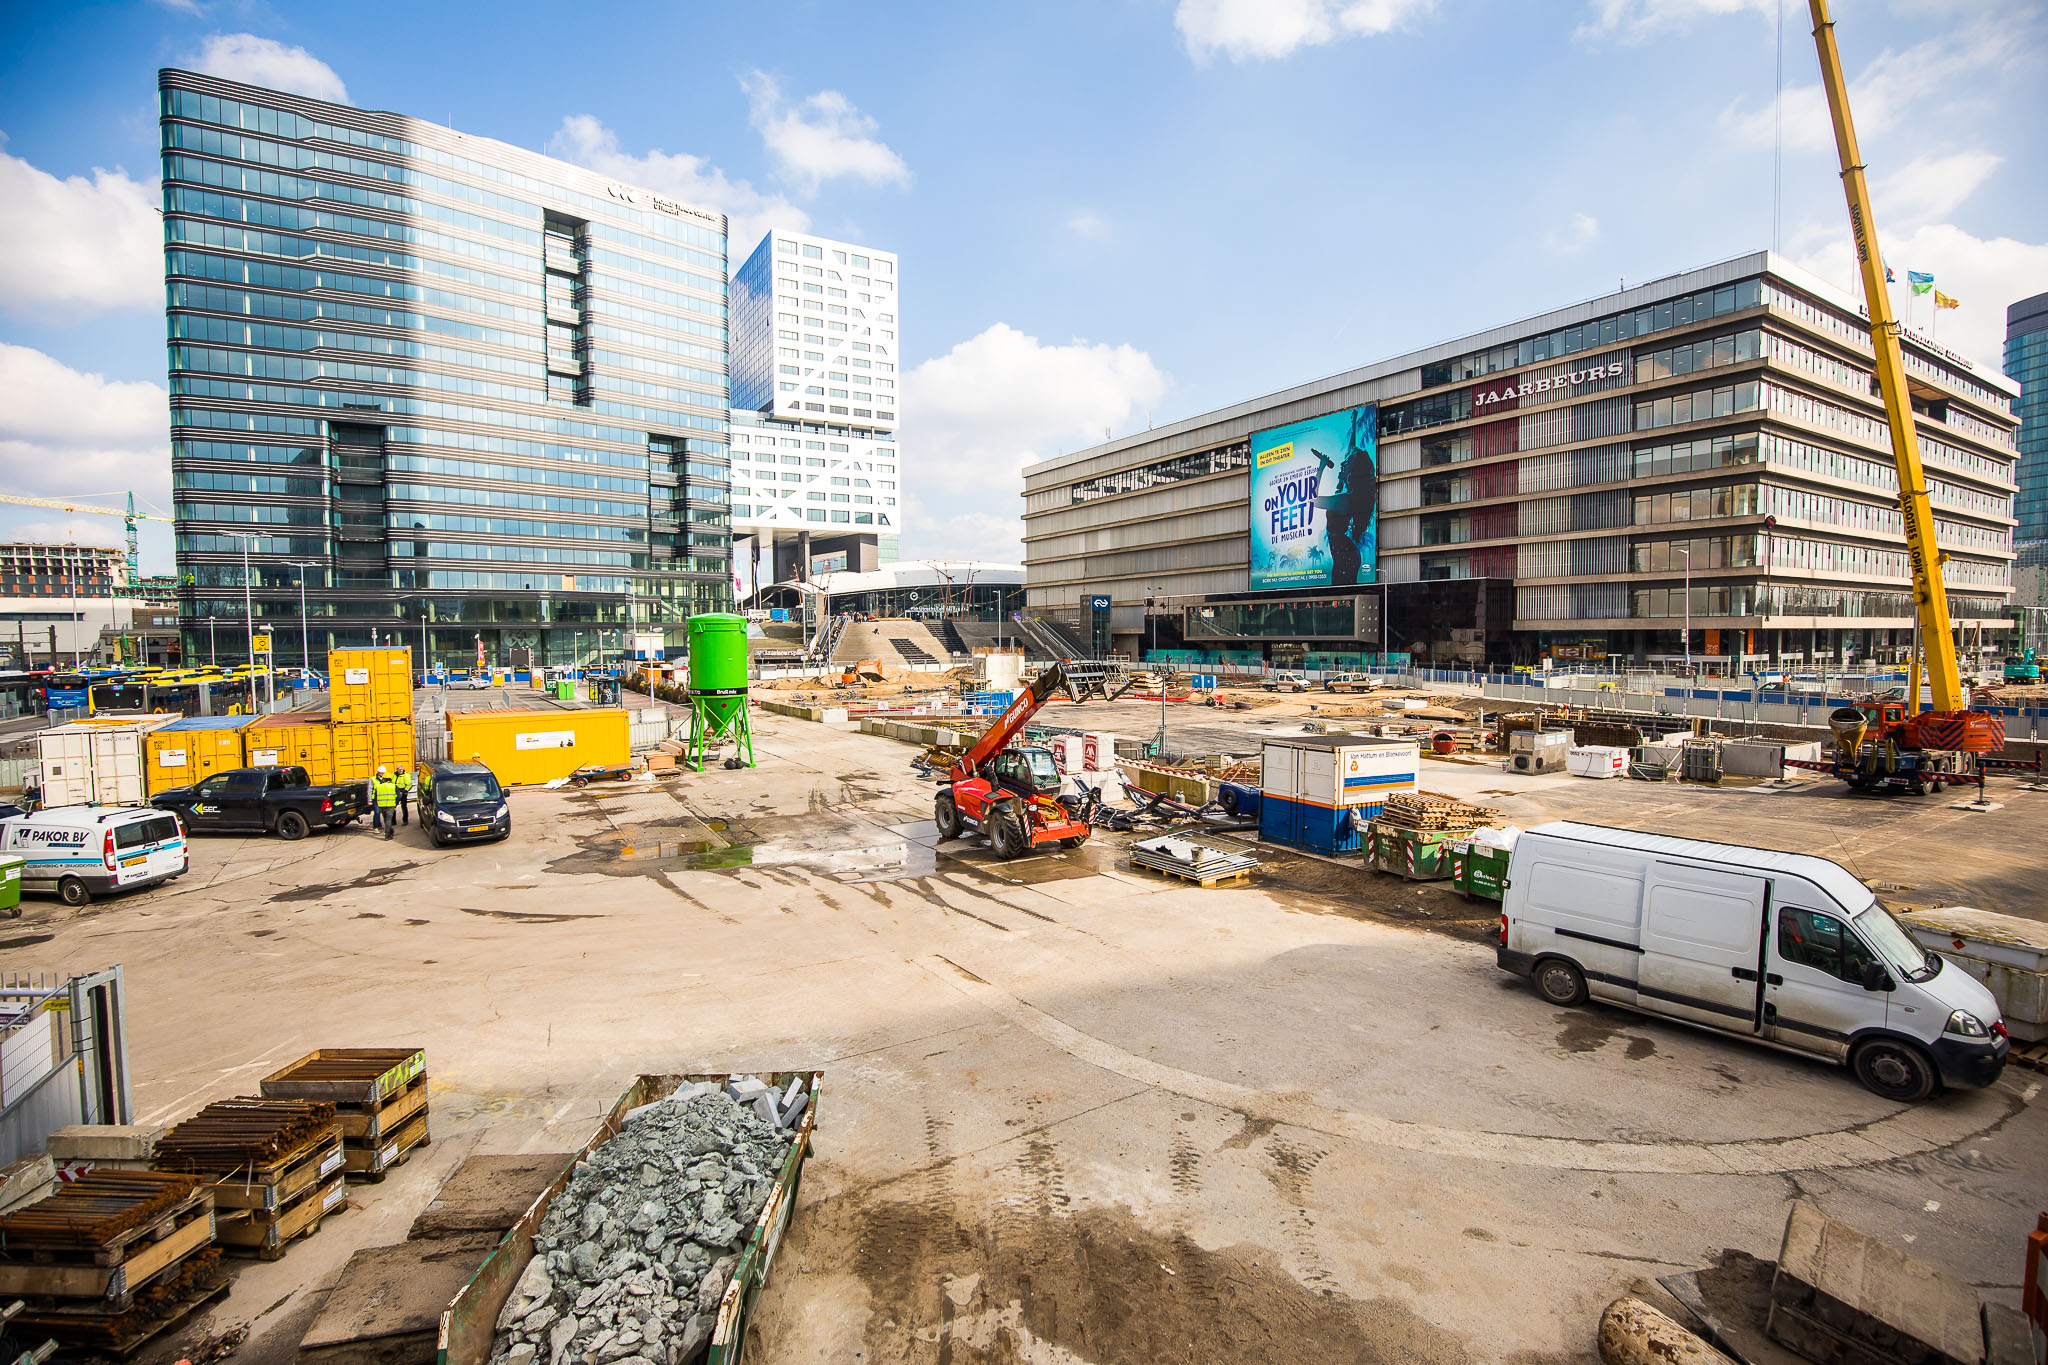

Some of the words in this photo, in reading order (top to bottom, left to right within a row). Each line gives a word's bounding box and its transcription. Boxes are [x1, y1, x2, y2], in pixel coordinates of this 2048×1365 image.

[1475, 361, 1623, 406] JAARBEURS
[1277, 476, 1318, 504] YOUR
[1264, 495, 1279, 512] ON
[1271, 501, 1315, 536] FEET!
[1271, 535, 1279, 544] DE
[1281, 528, 1306, 541] MUSICAL
[1009, 697, 1029, 723] GUNCO
[1385, 750, 1412, 758] Blankevoort
[31, 830, 69, 842] PAKOR
[72, 831, 90, 843] BV
